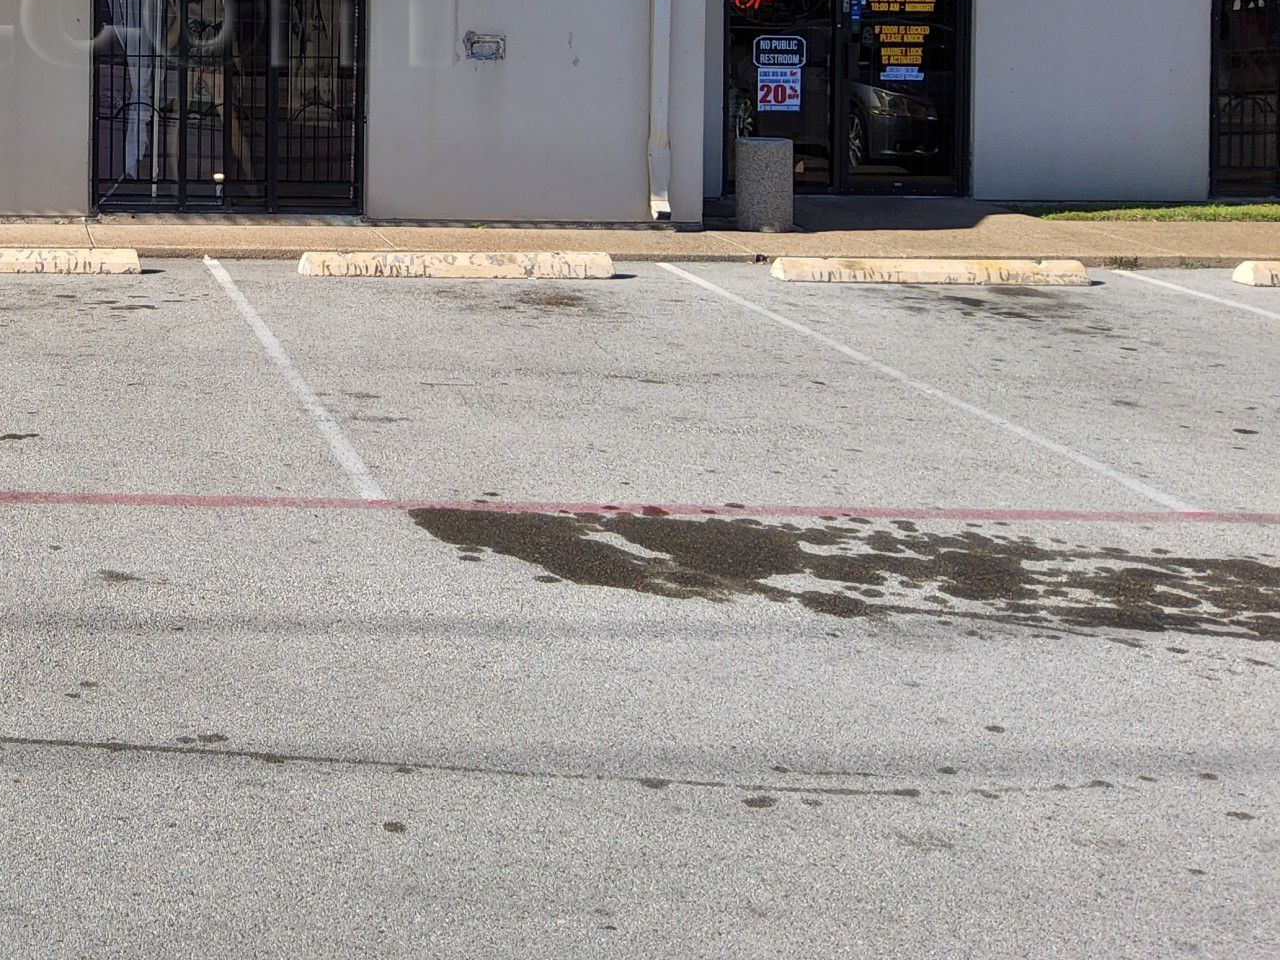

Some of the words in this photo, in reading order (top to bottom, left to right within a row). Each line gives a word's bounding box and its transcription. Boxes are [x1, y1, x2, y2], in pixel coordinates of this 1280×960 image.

[889, 3, 900, 12] AM
[882, 26, 898, 34] DOOR
[899, 26, 906, 34] IS
[906, 26, 930, 35] LOCKED
[880, 34, 902, 43] PLEASE
[760, 40, 771, 50] NO
[771, 40, 798, 50] PUBLIC
[907, 47, 923, 56] LOCK
[760, 53, 800, 64] RESTROOM
[759, 84, 787, 104] 20
